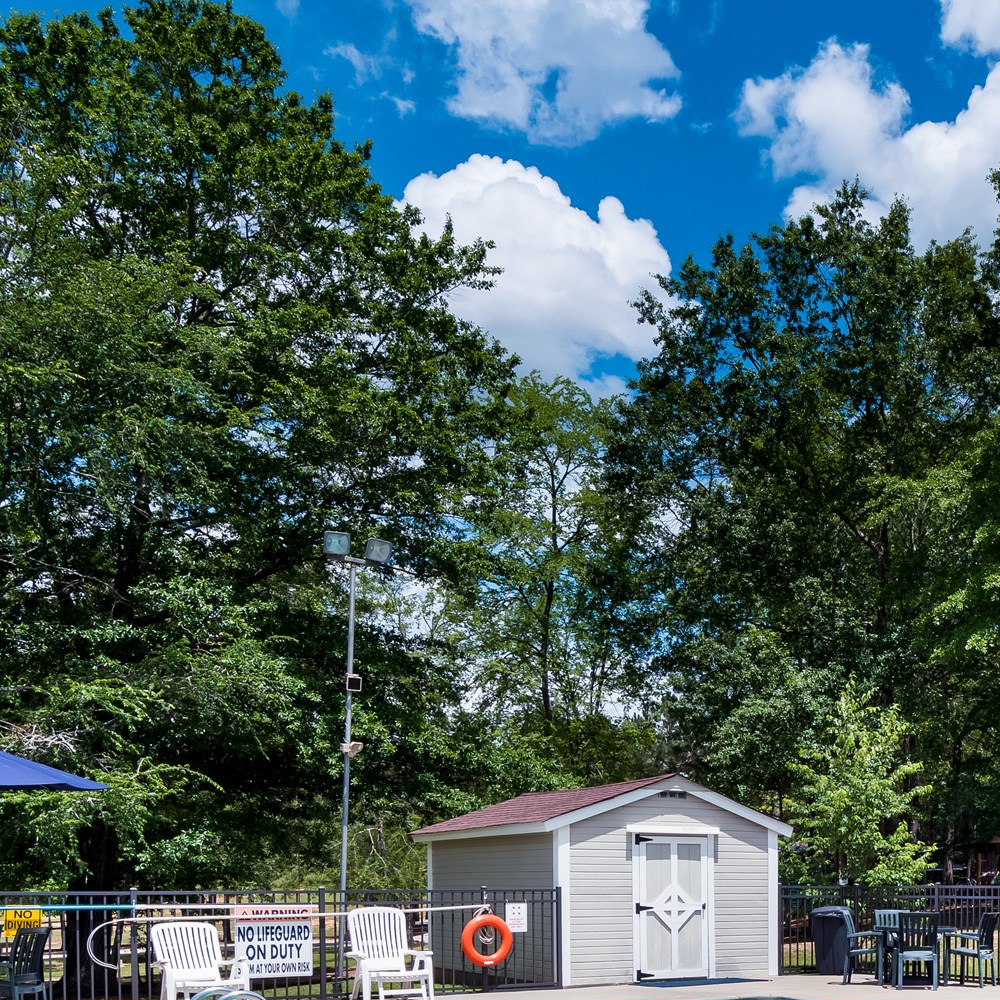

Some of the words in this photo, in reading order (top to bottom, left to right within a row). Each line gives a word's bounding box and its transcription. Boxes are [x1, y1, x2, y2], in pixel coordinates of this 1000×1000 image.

[14, 910, 33, 919] NO
[8, 920, 39, 930] DIVING
[237, 926, 254, 942] NO
[257, 925, 310, 941] LIFEGUARD
[246, 944, 266, 960] ON
[271, 943, 302, 959] DUTY
[256, 963, 263, 974] AT
[264, 962, 280, 974] YOUR
[281, 962, 296, 973] OWN
[298, 961, 310, 972] RISK
